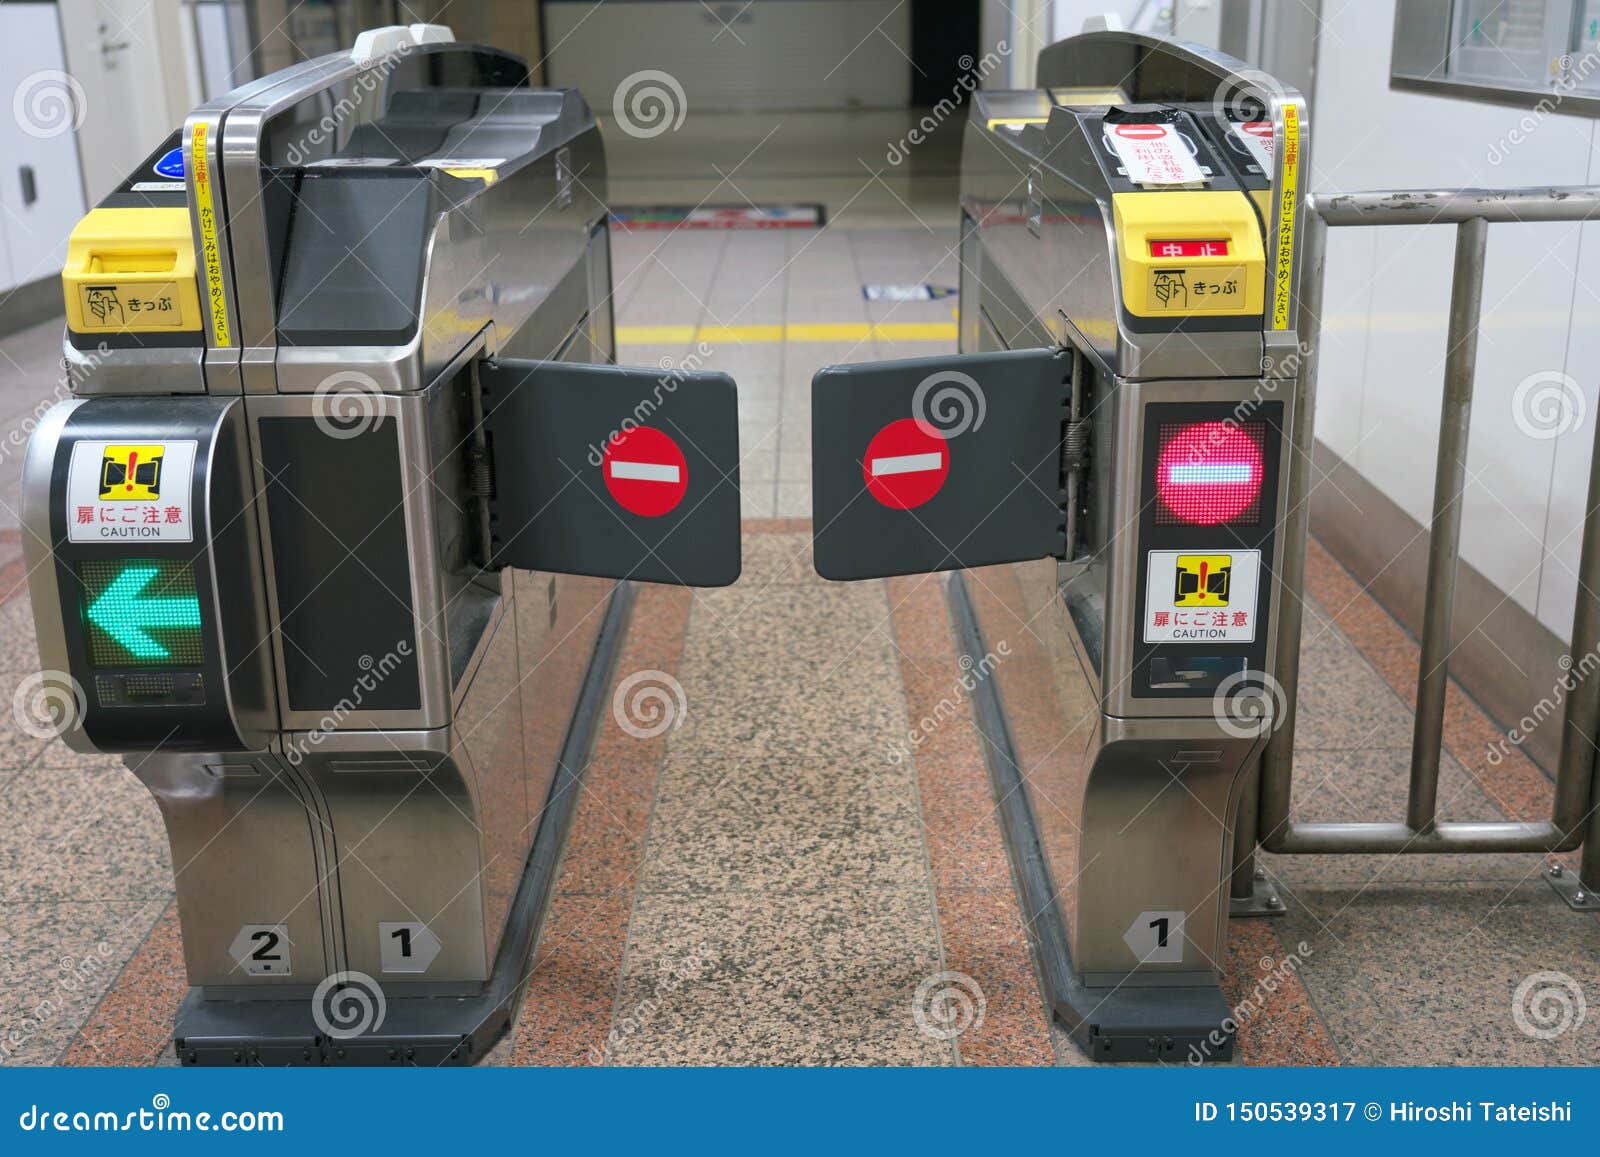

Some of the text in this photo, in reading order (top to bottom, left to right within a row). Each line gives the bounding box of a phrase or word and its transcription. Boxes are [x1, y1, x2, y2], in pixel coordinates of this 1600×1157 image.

[1162, 243, 1217, 257] 中止
[1275, 188, 1295, 324] かけこみはおやめください
[201, 207, 228, 341] かけこみはおやめください
[1193, 280, 1238, 295] きっぷ
[127, 297, 172, 312] きっぷ
[77, 505, 183, 524] 扉にご注意
[100, 527, 160, 537] CAUTION
[1153, 611, 1248, 627] 扉にご注意
[1173, 629, 1227, 638] CAUTION
[1149, 917, 1169, 948] 1
[251, 930, 281, 961] 2
[391, 928, 412, 957] 1
